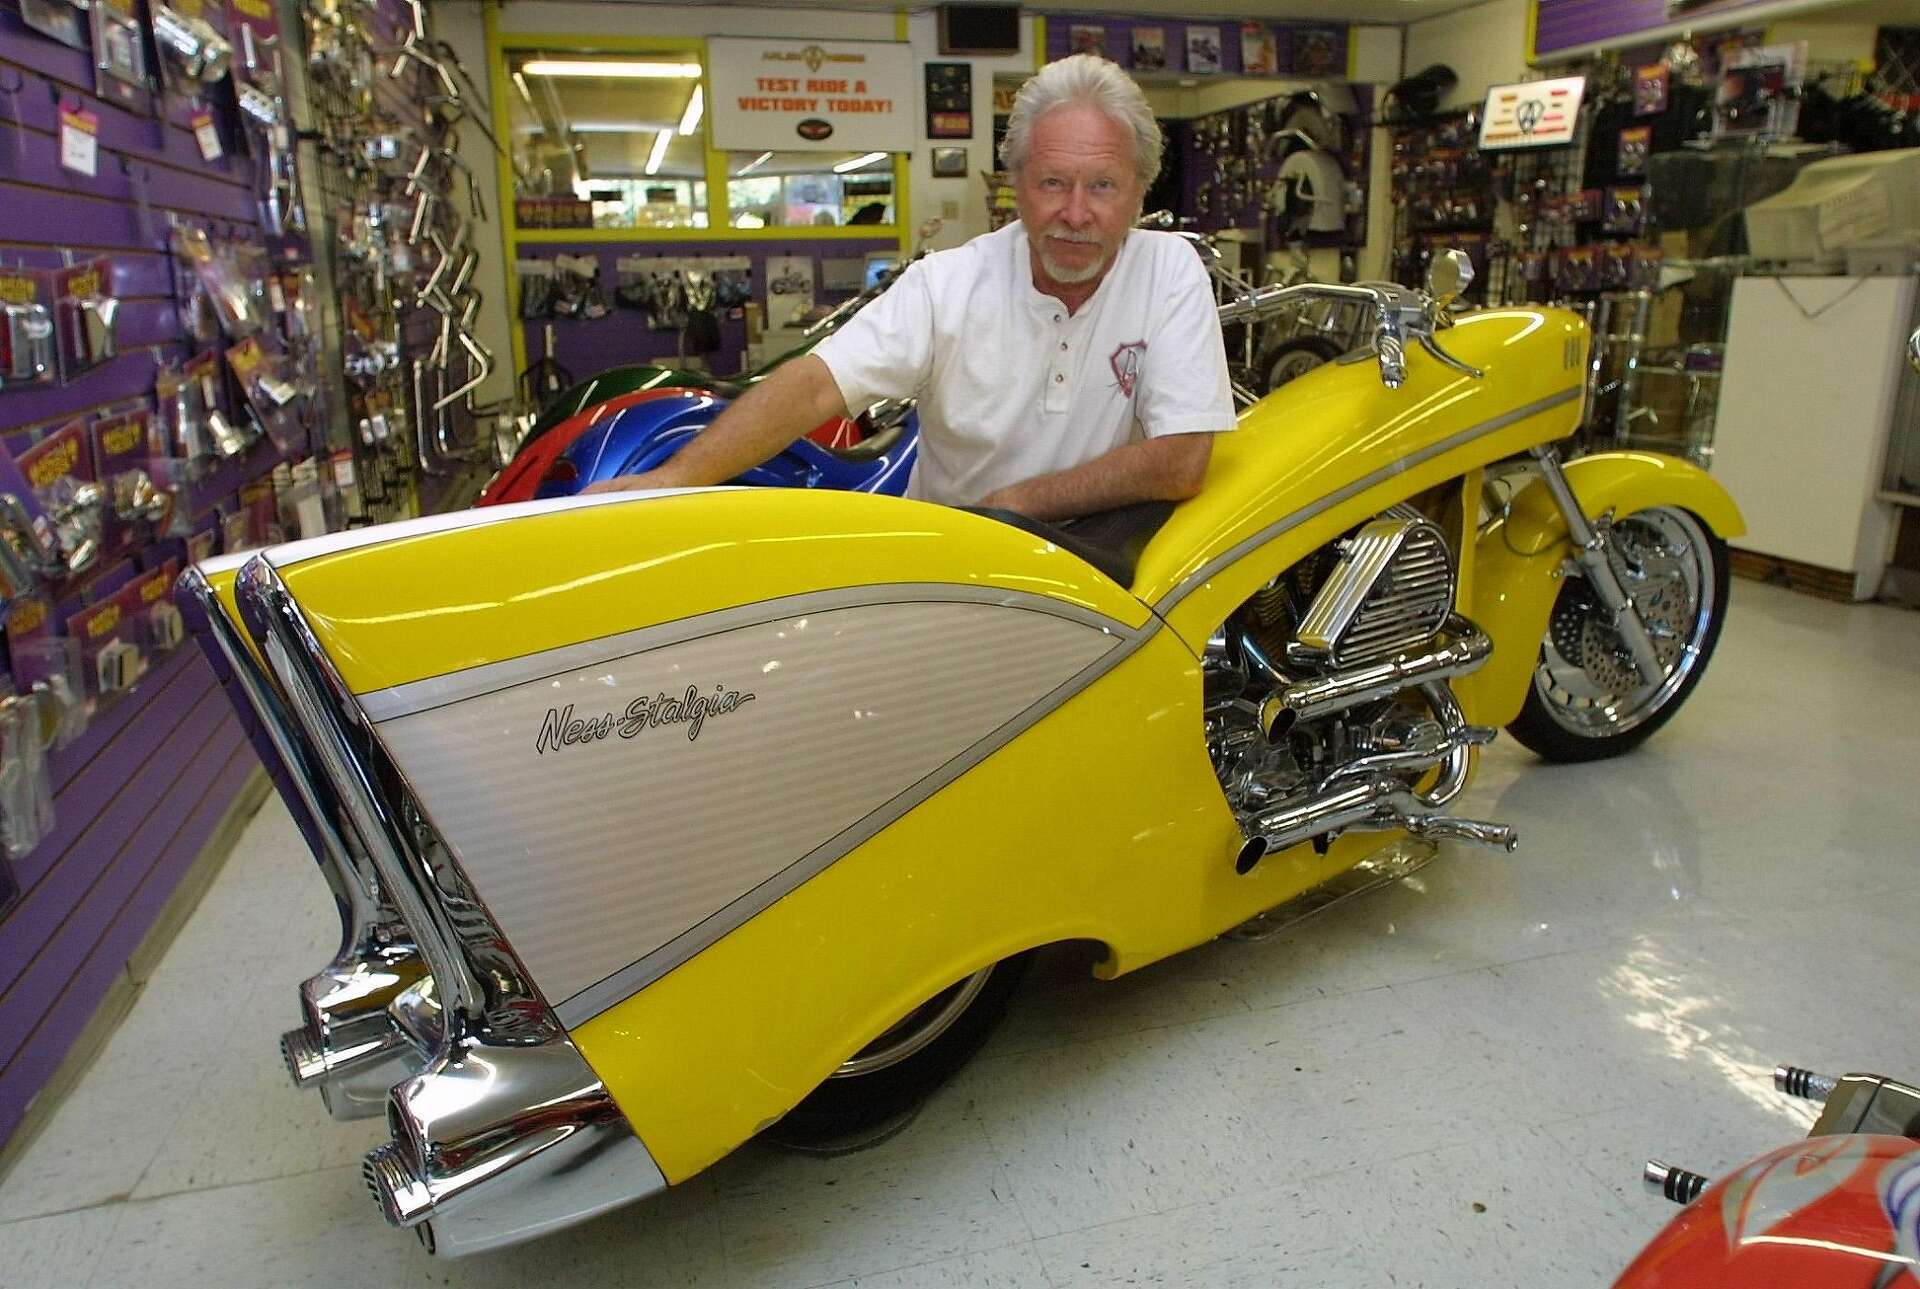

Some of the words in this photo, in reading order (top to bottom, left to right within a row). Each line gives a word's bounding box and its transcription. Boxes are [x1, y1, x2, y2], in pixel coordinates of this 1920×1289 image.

[757, 78, 800, 92] TEST
[806, 79, 849, 93] RIDE
[855, 80, 867, 93] A
[738, 98, 818, 112] VICTORY
[828, 99, 892, 113] TODAY!
